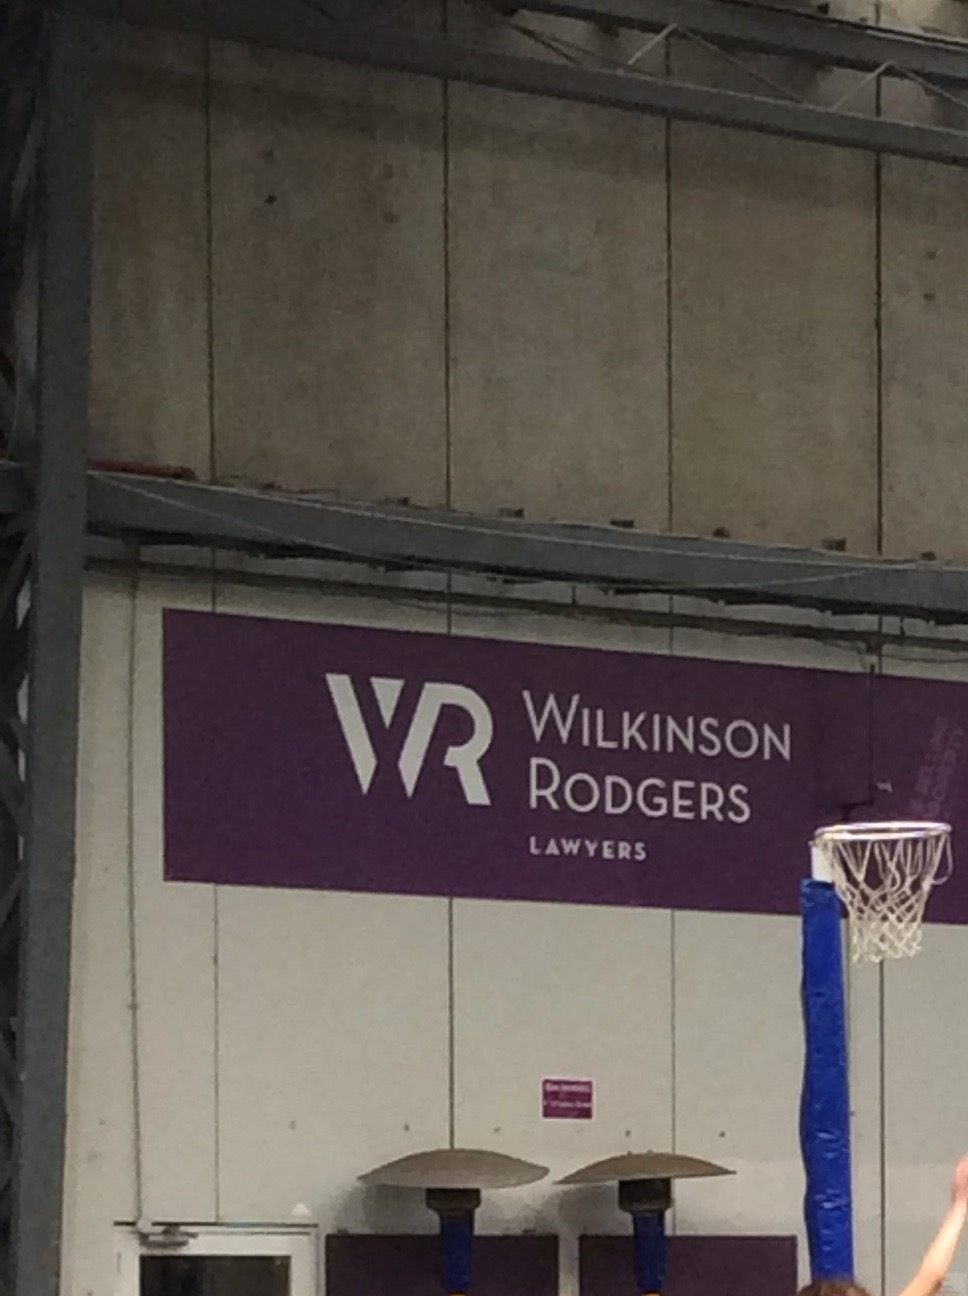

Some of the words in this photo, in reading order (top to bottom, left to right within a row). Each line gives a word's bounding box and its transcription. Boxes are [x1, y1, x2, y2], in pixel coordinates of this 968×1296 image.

[523, 690, 791, 760] WILKINSON
[529, 757, 751, 823] RODGERS
[529, 836, 647, 860] LAWYERS
